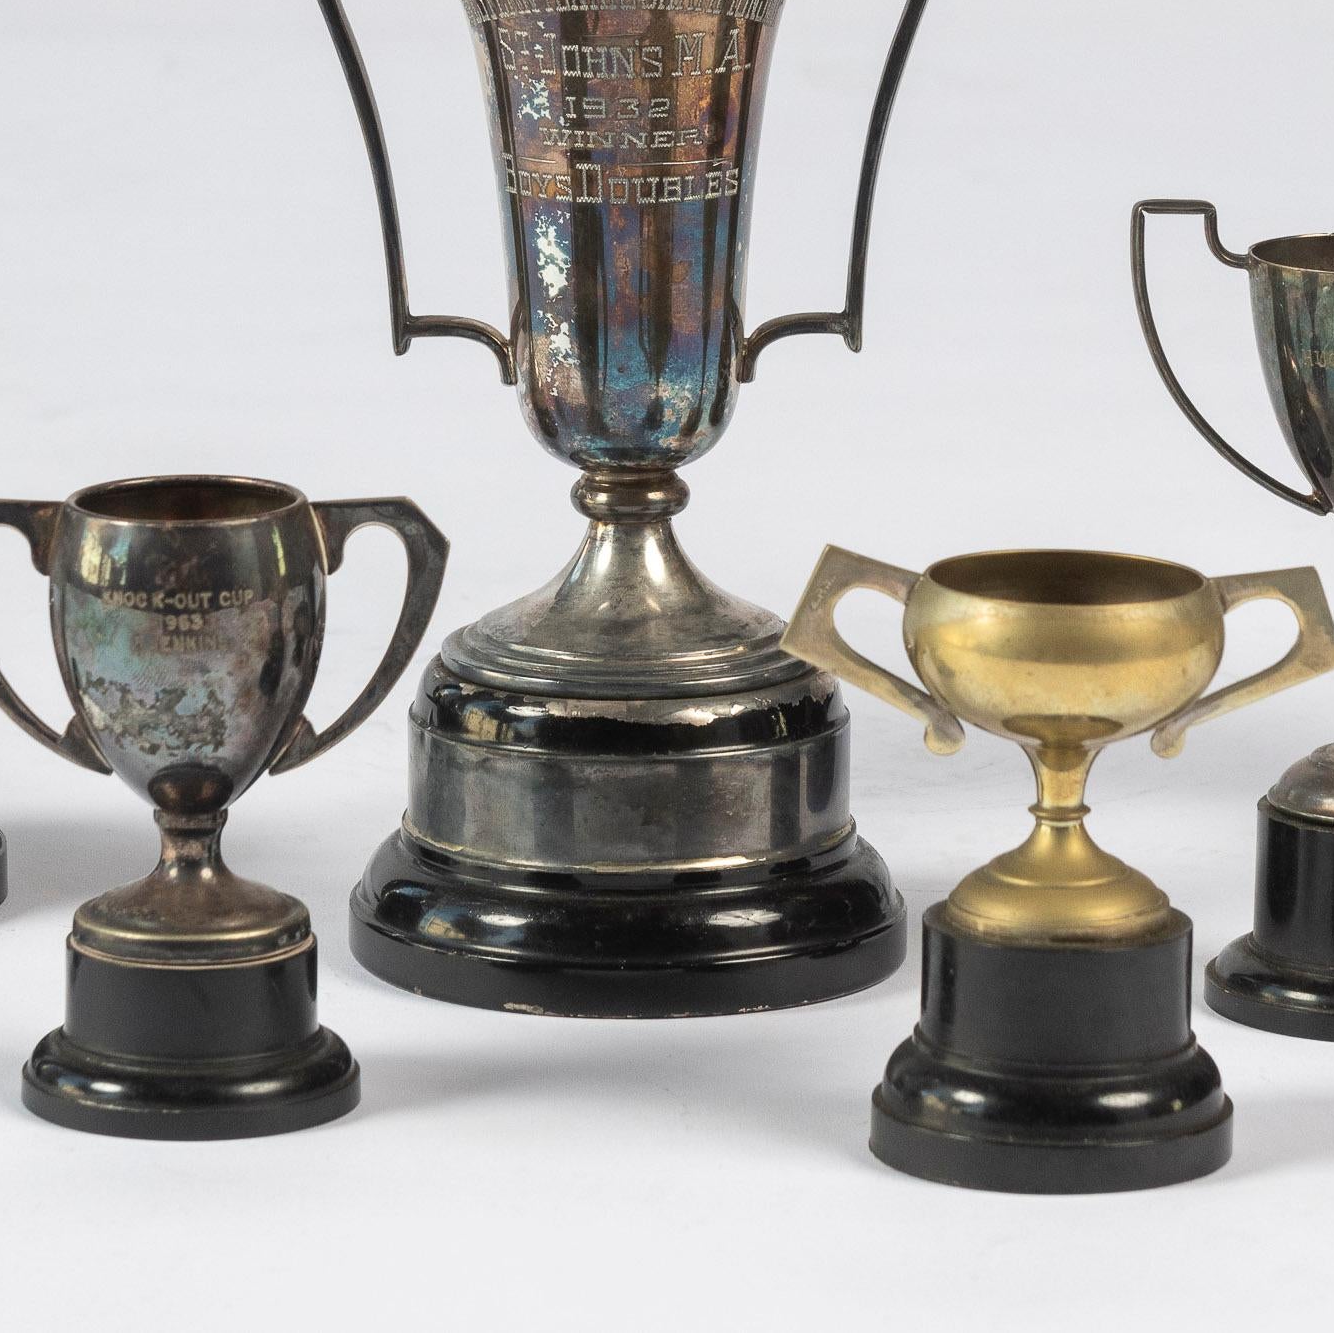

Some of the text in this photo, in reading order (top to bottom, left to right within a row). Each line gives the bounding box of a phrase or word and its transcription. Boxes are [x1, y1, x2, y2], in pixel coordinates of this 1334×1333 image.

[565, 95, 671, 118] 1932
[502, 152, 740, 204] BOYS DOUBLES
[219, 589, 254, 607] CUP
